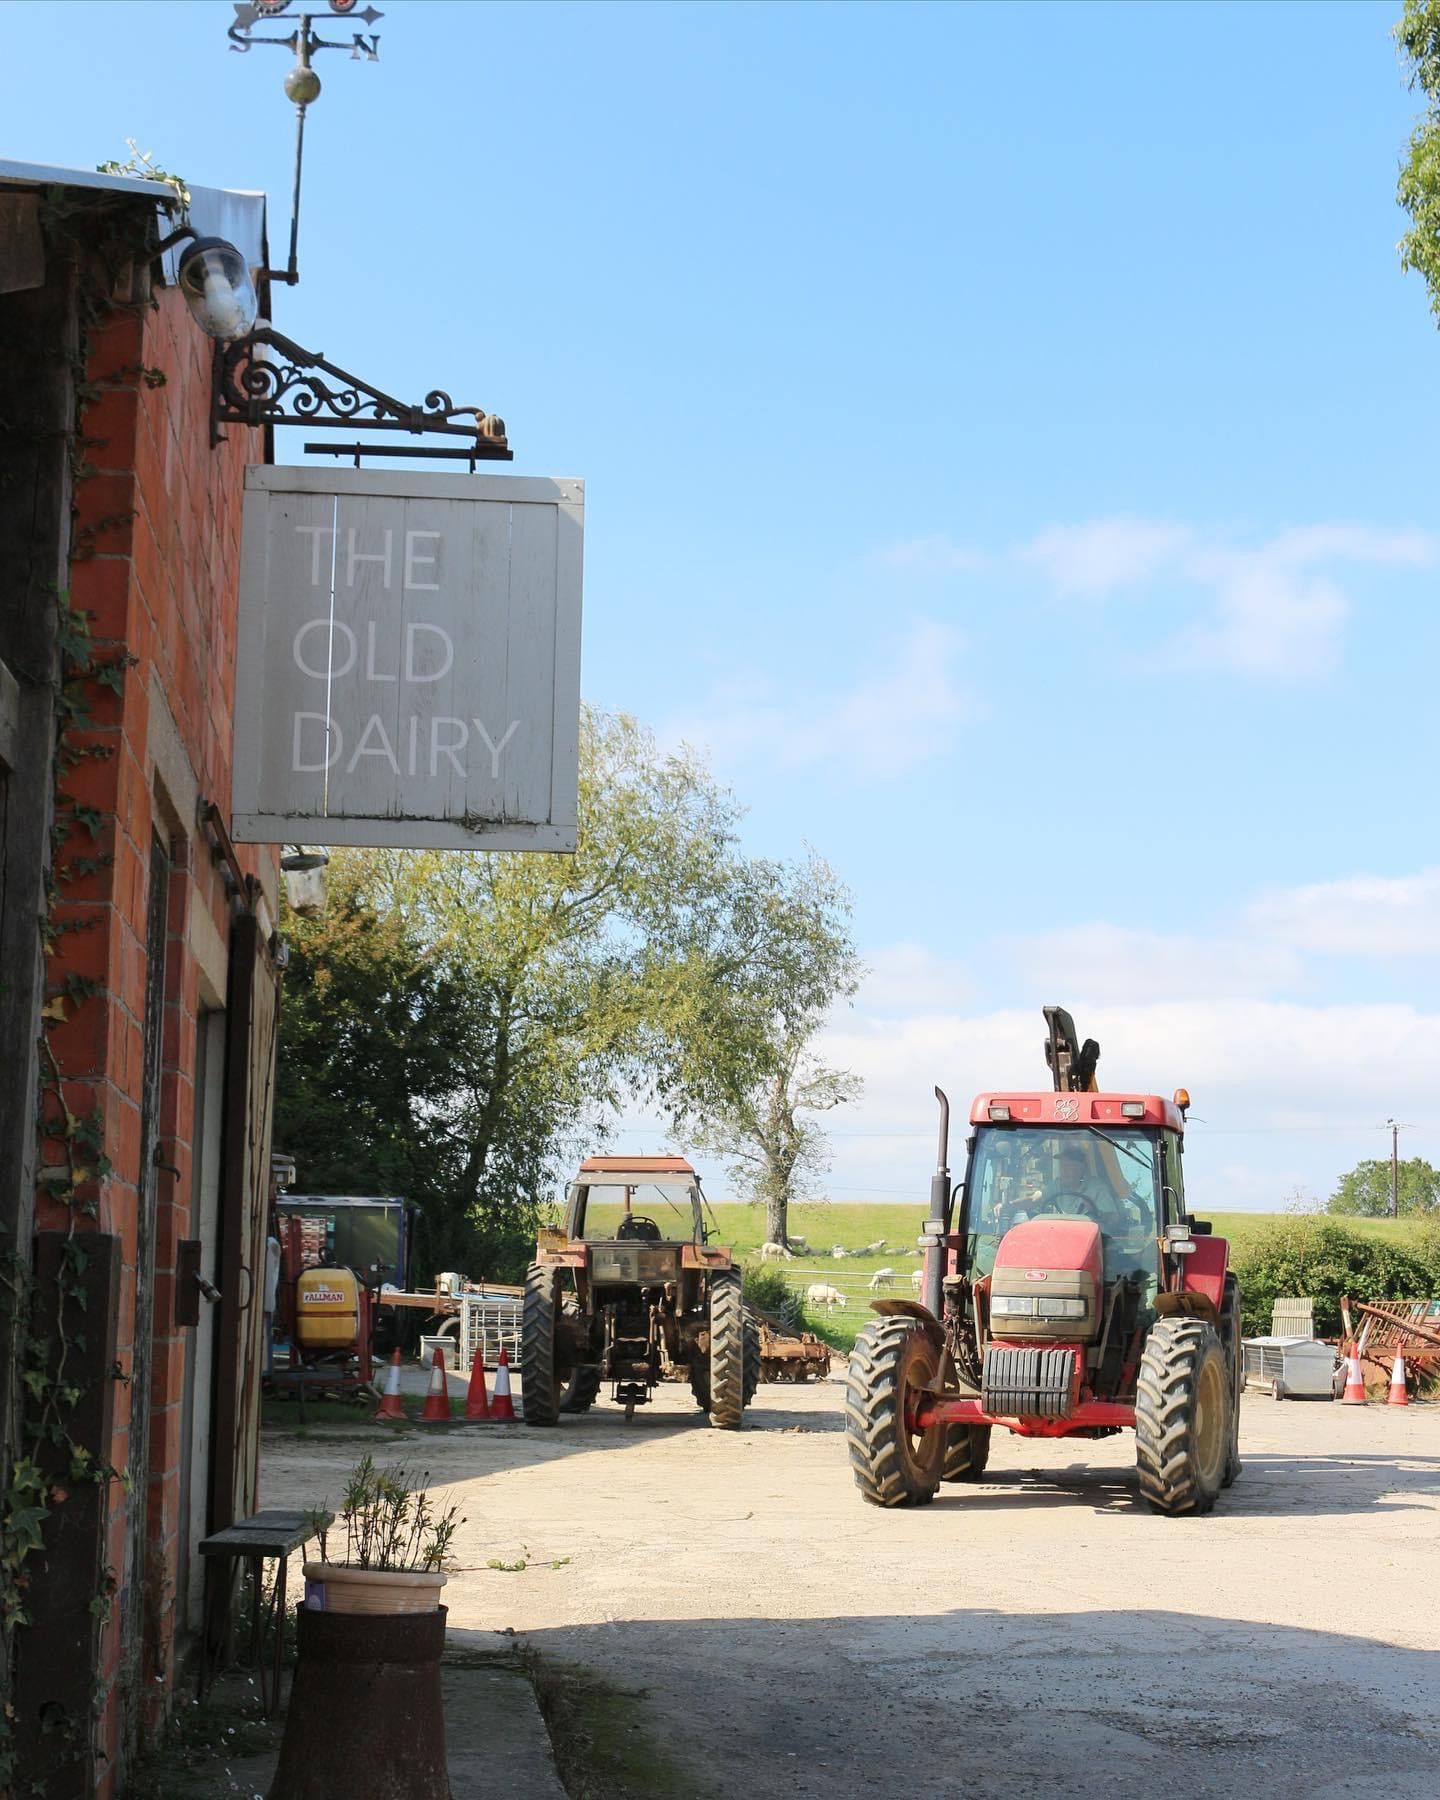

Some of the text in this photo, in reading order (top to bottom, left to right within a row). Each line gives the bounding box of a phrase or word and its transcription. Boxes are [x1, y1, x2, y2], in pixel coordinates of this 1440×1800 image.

[350, 33, 381, 61] N
[294, 525, 441, 591] THE
[293, 618, 454, 682] OLD
[291, 711, 520, 779] DAIRY
[309, 1293, 343, 1301] ALLMAN
